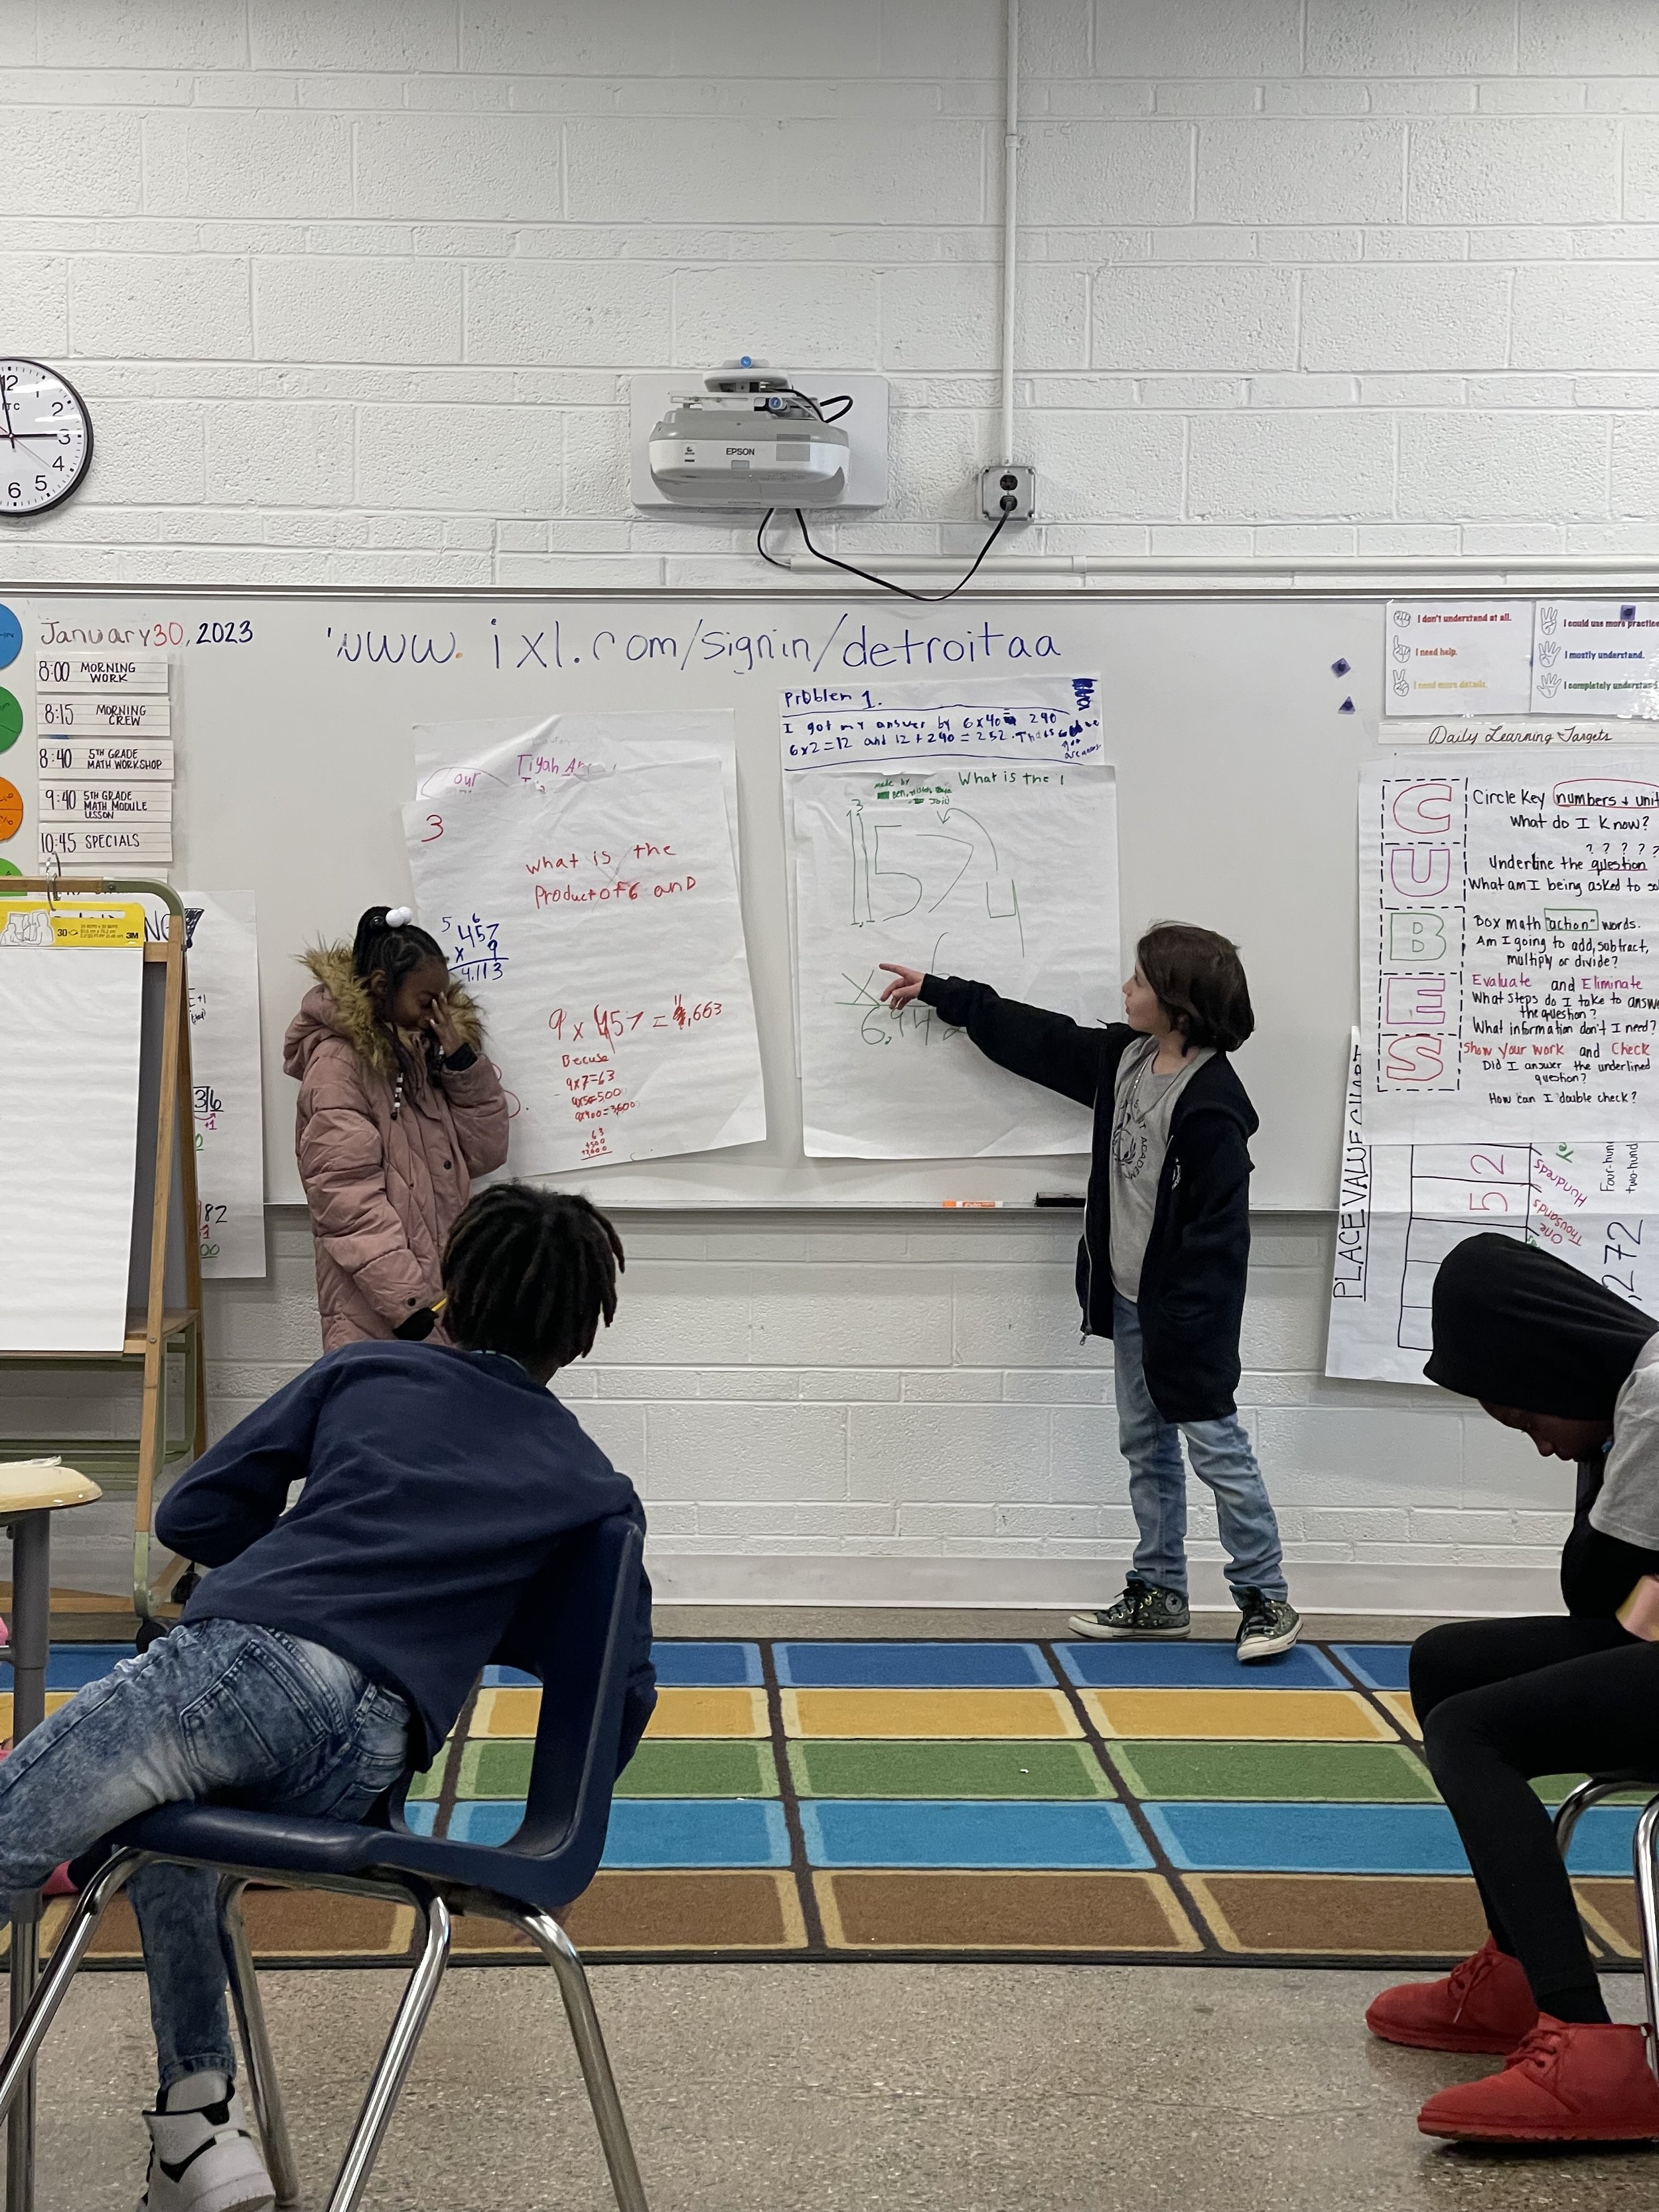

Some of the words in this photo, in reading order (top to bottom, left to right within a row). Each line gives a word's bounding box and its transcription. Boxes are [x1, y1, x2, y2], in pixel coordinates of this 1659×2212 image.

[51, 402, 64, 417] 2
[726, 447, 755, 456] EPSON
[52, 456, 65, 472] 4
[7, 482, 22, 498] 6
[35, 475, 48, 492] 5
[1417, 615, 1420, 623] I
[1422, 615, 1441, 623] don't
[1443, 613, 1488, 623] understand
[1500, 613, 1512, 622] all.
[1568, 619, 1589, 628] could
[40, 621, 153, 646] January
[196, 620, 253, 644] 2023
[1420, 648, 1438, 656] need
[1440, 647, 1458, 658] help.
[1565, 650, 1567, 659] I
[1569, 650, 1596, 660] mostly
[1598, 650, 1645, 659] understand.
[38, 660, 70, 682] 8:00
[80, 662, 136, 673] MORNING
[90, 672, 128, 683] WORK
[1569, 681, 1611, 691] completely
[44, 703, 74, 725] 8:15
[96, 704, 147, 716] MORNING
[108, 715, 141, 726] CREW
[782, 723, 794, 733] I
[807, 720, 831, 735] got
[1429, 725, 1479, 745] Daily
[1484, 725, 1554, 745] Learning
[1557, 725, 1613, 745] Targets
[863, 733, 887, 746] and
[895, 735, 911, 745] 12
[39, 749, 72, 769] 8:40
[88, 749, 105, 759] 5TH
[108, 749, 138, 759] GRADE
[87, 760, 111, 770] MATH
[114, 760, 163, 770] WORKSHOP
[958, 771, 997, 786] What
[1003, 771, 1016, 783] is
[1023, 773, 1049, 784] the
[45, 789, 77, 810] 9:40
[84, 790, 100, 800] 5TH
[102, 790, 132, 801] GRADE
[84, 800, 108, 811] MATH
[111, 800, 148, 812] MODULE
[1473, 788, 1517, 805] Circle
[1555, 792, 1617, 806] numbers
[84, 810, 115, 820] LESSON
[1393, 783, 1452, 834] C
[421, 814, 444, 843] 3
[1552, 814, 1570, 829] do
[1575, 818, 1590, 830] I
[40, 832, 77, 854] 10:45
[84, 834, 140, 849] SPECIALS
[593, 849, 612, 866] is
[633, 842, 678, 861] the
[1390, 848, 1451, 897] U
[1488, 852, 1555, 871] Underline
[1560, 855, 1584, 871] the
[1591, 856, 1646, 876] question
[1468, 876, 1505, 891] What
[1508, 880, 1526, 891] am
[1527, 879, 1541, 891] I
[1547, 877, 1583, 897] being
[1626, 877, 1641, 892] to
[1473, 915, 1501, 930] Box
[1506, 915, 1542, 930] math
[1601, 917, 1642, 931] words.
[57, 928, 68, 937] 30
[1390, 912, 1447, 962] B
[1476, 935, 1498, 947] Am
[1502, 936, 1512, 945] I
[1514, 934, 1547, 954] going
[1552, 935, 1565, 949] to
[1571, 937, 1596, 957] add,
[1597, 938, 1650, 954] subtract,
[1506, 952, 1553, 971] multiply
[1558, 957, 1570, 967] or
[1574, 954, 1619, 969] divide?
[1472, 972, 1532, 988] Evaluate
[1551, 976, 1575, 993] and
[1581, 975, 1644, 990] Eliminate
[1386, 977, 1446, 1025] E
[1472, 991, 1505, 1005] What
[1545, 994, 1557, 1007] do
[1561, 997, 1573, 1007] I
[1578, 994, 1605, 1007] take
[1610, 992, 1622, 1005] to
[1519, 1005, 1539, 1019] the
[1473, 1016, 1504, 1034] What
[1510, 1020, 1573, 1035] information
[1579, 1019, 1607, 1036] don't
[1611, 1023, 1621, 1033] I
[1625, 1019, 1657, 1035] need?
[1386, 1034, 1444, 1082] S
[1532, 1043, 1565, 1056] work
[1579, 1042, 1601, 1059] and
[1611, 1041, 1650, 1056] Check
[1482, 1058, 1502, 1071] Did
[1507, 1061, 1519, 1071] I
[1524, 1061, 1563, 1070] answer
[1573, 1061, 1592, 1071] the
[1598, 1058, 1651, 1072] underlined
[1534, 1072, 1587, 1086] question?
[1488, 1092, 1512, 1104] How
[1517, 1094, 1536, 1104] can
[1543, 1093, 1554, 1103] I
[1559, 1090, 1592, 1104] double
[1597, 1091, 1637, 1104] check?
[1533, 1158, 1588, 1208] Hundreds
[1469, 1191, 1509, 1213] 5
[1532, 1199, 1584, 1247] Thousands
[1539, 1222, 1563, 1245] One
[1333, 1209, 1366, 1299] PLACE
